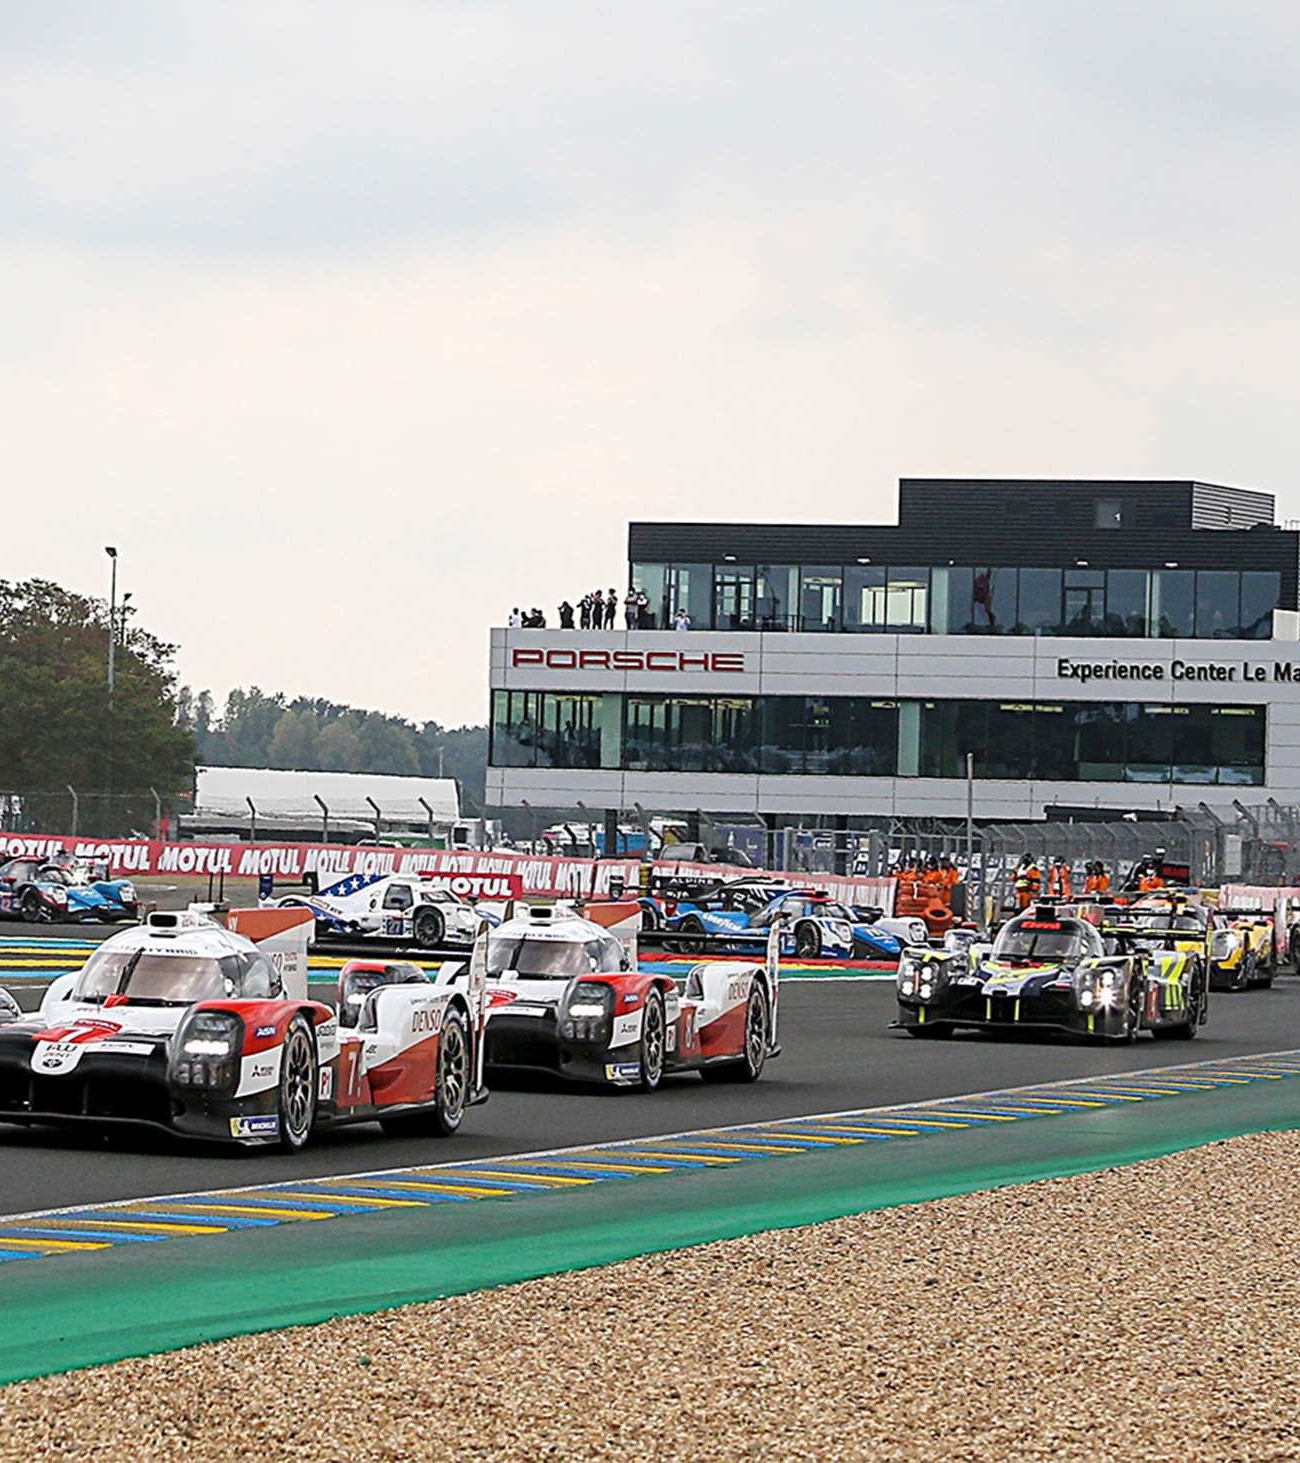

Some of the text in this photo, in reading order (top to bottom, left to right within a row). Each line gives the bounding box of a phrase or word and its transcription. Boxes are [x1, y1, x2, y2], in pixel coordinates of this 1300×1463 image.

[513, 649, 744, 671] PORSCHE
[1057, 658, 1163, 683] Experience
[1171, 660, 1236, 681] Center
[1243, 662, 1266, 681] Le
[75, 843, 150, 870] MOTUL
[157, 846, 232, 873] MOTUL
[238, 849, 300, 874] MOTUL
[303, 849, 351, 873] MOTUL
[354, 850, 395, 875] MOTUL
[431, 875, 512, 896] MOTUL
[669, 877, 714, 885] ALPINE
[412, 1009, 442, 1033] DENSO
[58, 1027, 94, 1043] 7
[348, 1051, 358, 1096] 7
